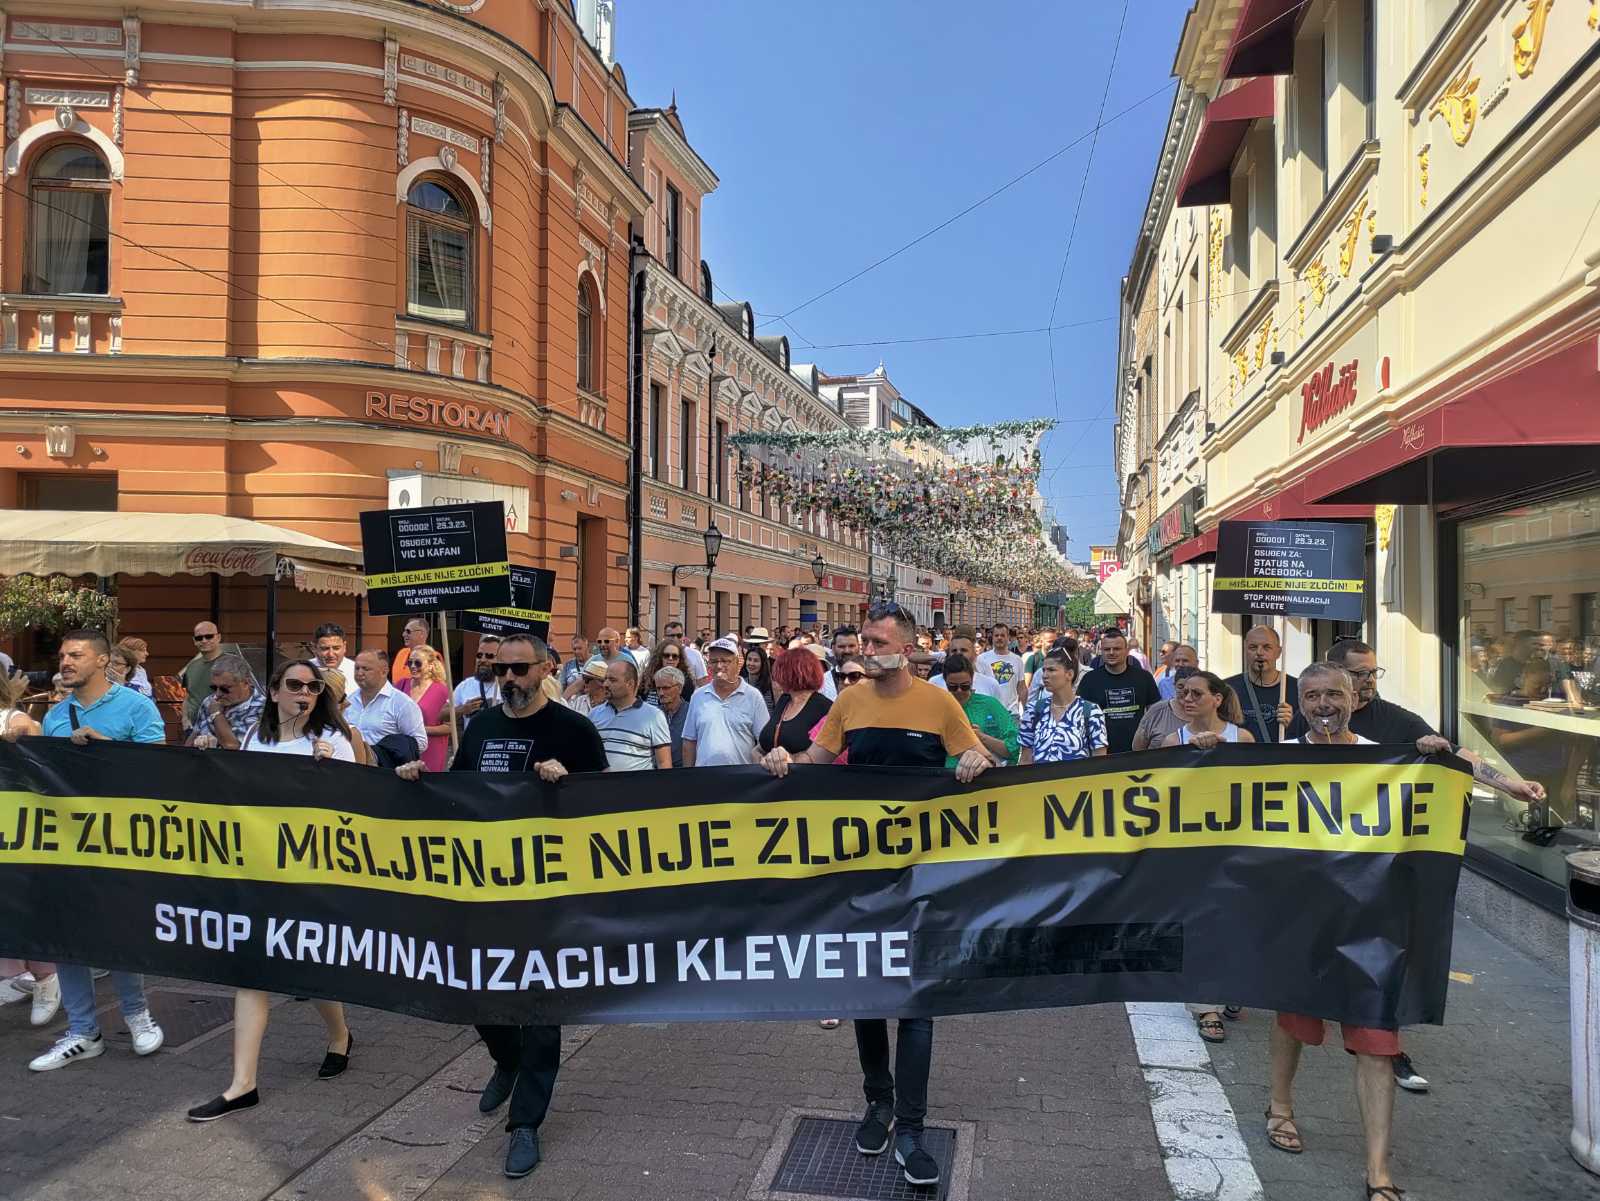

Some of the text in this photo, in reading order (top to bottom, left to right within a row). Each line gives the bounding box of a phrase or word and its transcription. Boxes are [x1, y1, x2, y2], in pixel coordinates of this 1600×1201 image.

[364, 391, 512, 439] RESTORAN
[1294, 537, 1327, 546] 25.3.23.
[401, 546, 460, 559] VIC U KAFANI
[1254, 559, 1305, 568] STATUS NA
[380, 573, 432, 586] MIŠLJENJE
[434, 570, 456, 580] NIJE
[458, 566, 494, 578] ZLOČIN!
[1253, 568, 1313, 577] FACEBOOK-U
[1229, 579, 1282, 589] MIŠLJENJE
[1285, 581, 1307, 589] NIJE
[1310, 580, 1348, 590] ZLOČIN!
[397, 585, 479, 597] STOP KRIMINALIZACIJI
[405, 597, 438, 605] KLEVETE
[1243, 593, 1330, 605] STOP KRIMINALIZACIJI
[1250, 602, 1285, 610] KLEVETE
[70, 804, 244, 866] ZLOČIN!
[277, 815, 568, 887] MIŠLJENJE
[589, 820, 735, 879] NIJE
[756, 801, 1000, 865] ZLOČIN!
[1043, 773, 1434, 840] MIŠLJENJE
[155, 902, 911, 991] STOP KRIMINALIZACIJI KLEVETE
